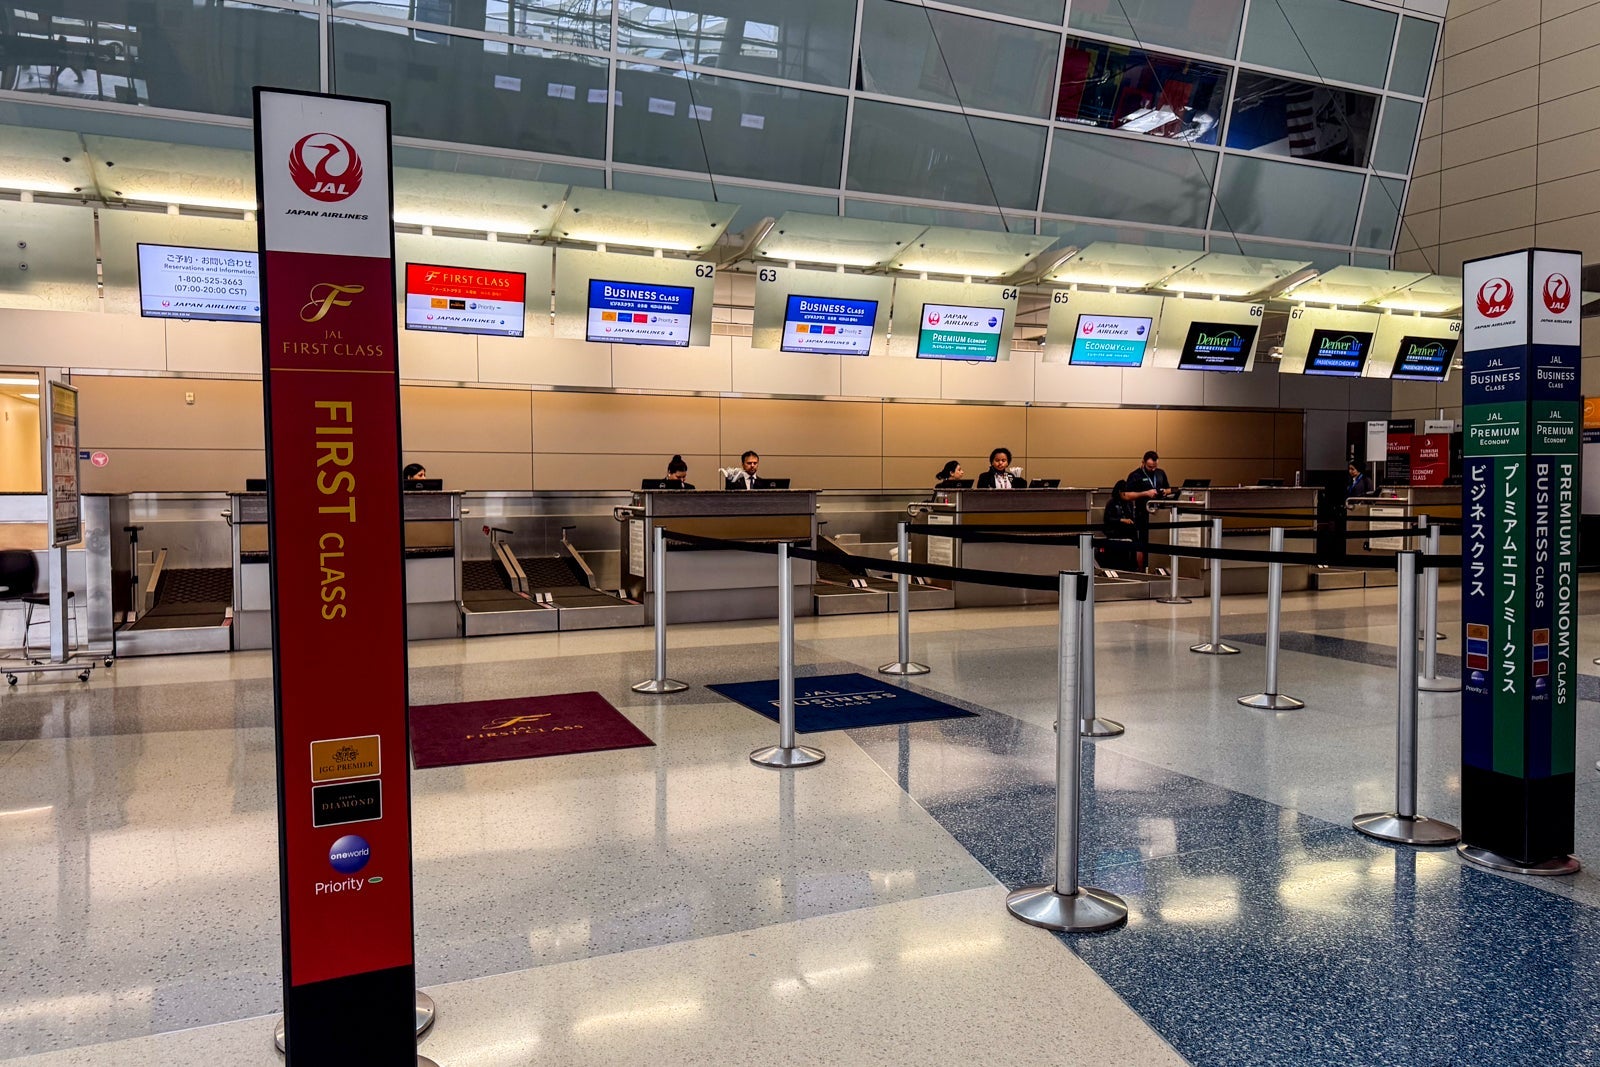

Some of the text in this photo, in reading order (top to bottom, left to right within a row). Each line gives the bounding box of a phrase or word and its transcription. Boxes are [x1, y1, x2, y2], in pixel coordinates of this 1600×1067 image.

[309, 181, 350, 195] JAL
[285, 208, 369, 221] JAPAN AIRLINES
[166, 254, 252, 268] ご予約・お問い合わせ
[164, 263, 205, 272] Reservations
[220, 267, 256, 275] Information
[695, 264, 714, 278] 62
[178, 276, 243, 286] 1-800-525-3663
[443, 274, 474, 285] FIRST
[476, 276, 510, 288] CLASS
[759, 269, 777, 282] 63
[174, 284, 248, 296] (07:00-20:00 CST)
[604, 286, 680, 302] BUSINESS CLASS
[1002, 288, 1018, 300] 64
[1054, 292, 1069, 304] 65
[800, 300, 865, 315] BUSINESS CLASS
[1250, 306, 1263, 317] 66
[1486, 304, 1507, 315] JAL
[1550, 302, 1566, 310] JAL
[1292, 309, 1304, 320] 67
[1449, 322, 1461, 332] 68
[1491, 320, 1516, 328] AIRLINES
[325, 330, 344, 340] JAL
[932, 332, 966, 343] PREMIUM
[1196, 332, 1232, 346] Denver
[283, 341, 384, 357] FIRST CLASS
[1085, 341, 1121, 351] ECONOMY
[1320, 337, 1351, 350] Denver
[1408, 344, 1438, 356] Denver
[1487, 358, 1503, 368] JAL
[1550, 356, 1562, 364] JAL
[1470, 372, 1521, 385] BUSINESS
[1537, 369, 1575, 380] BUSINESS
[1485, 384, 1505, 392] CLASS
[1487, 412, 1503, 421] JAL
[1549, 410, 1562, 418] JAL
[1470, 427, 1520, 438] PREMIUM
[1536, 424, 1574, 436] PREMIUM
[1480, 438, 1510, 446] ECONOMY
[1544, 436, 1566, 444] ECONOMY
[314, 400, 356, 620] FIRST CLASS
[1470, 465, 1487, 597] ビジネスクラス
[1535, 464, 1549, 608] BUSINESS CLASS
[1502, 463, 1519, 694] プレミアムエコノミークラス
[1556, 464, 1572, 705] PREMIUM ECONOMY CLASS
[1465, 685, 1483, 694] Priority
[822, 700, 872, 708] CLASS
[466, 725, 584, 739] FIRST CLASS
[337, 760, 374, 771] PREMIER
[322, 798, 374, 811] DIAMOND
[330, 848, 370, 860] oneworld
[315, 878, 364, 895] Priority
